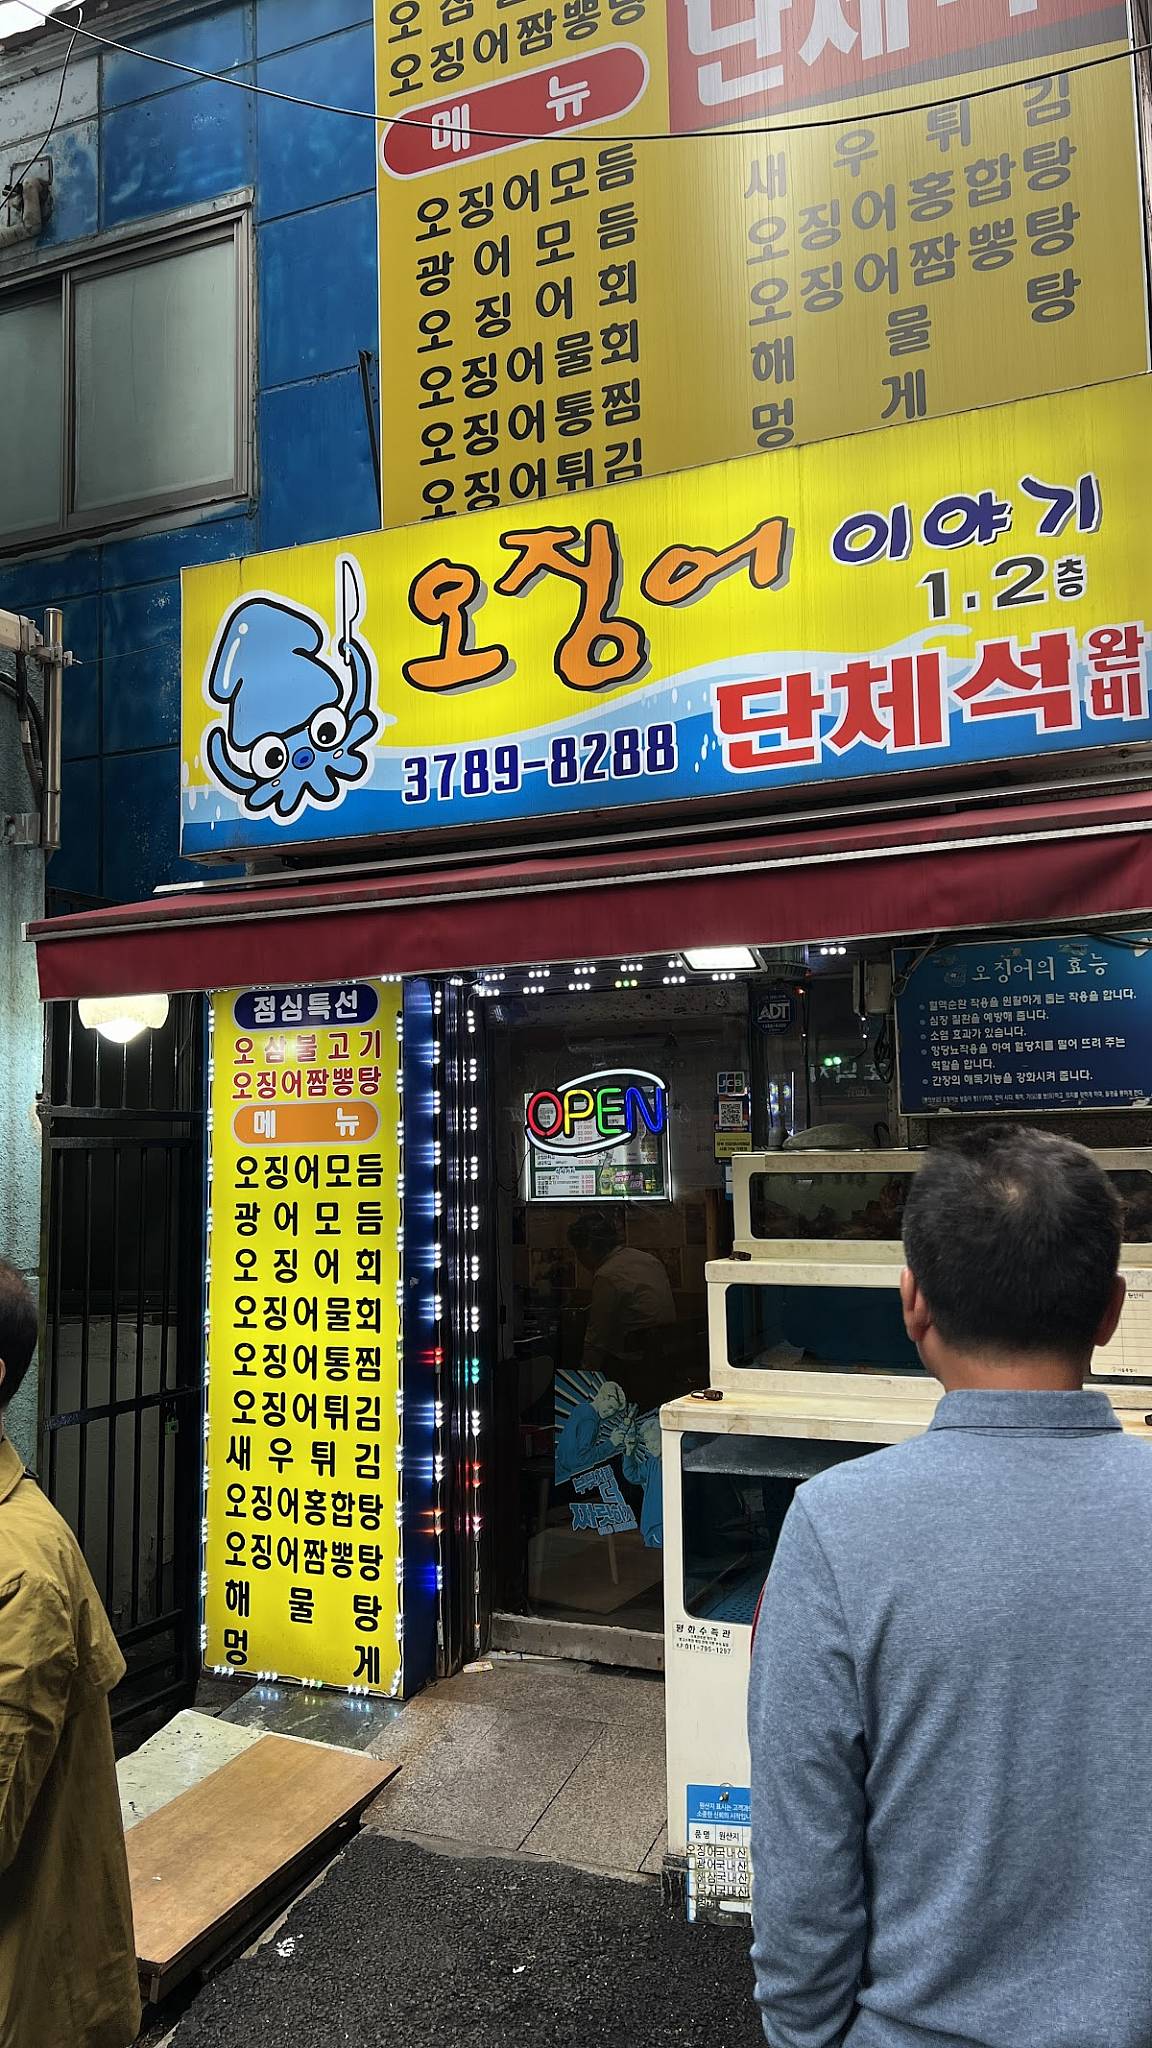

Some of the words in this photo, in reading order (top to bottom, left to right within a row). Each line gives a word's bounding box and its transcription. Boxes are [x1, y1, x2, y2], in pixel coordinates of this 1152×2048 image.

[415, 143, 638, 242] 오징어모듬
[746, 136, 1078, 265] 오징어홍합탕
[416, 201, 639, 297] 광어모듬
[748, 201, 1081, 327] 오징어짬뽕탕
[417, 260, 638, 353] 오징어회
[418, 319, 639, 410] 오징어물회
[419, 378, 641, 466] 오징어통찜
[420, 438, 643, 521] 오징어튀김
[402, 518, 793, 692] 오징어
[831, 473, 1100, 565] 이야기
[716, 632, 1074, 770] 단체석
[404, 723, 676, 803] 3789-8288
[972, 956, 1055, 983] 오징어의
[1067, 953, 1109, 976] 효능
[253, 990, 358, 1024] 점심특선
[757, 1002, 790, 1020] ADT
[929, 1015, 948, 1026] 심장
[951, 1013, 981, 1026] 질환을
[984, 1011, 1013, 1023] 예방해
[1016, 1009, 1049, 1021] 줍니다.
[970, 996, 999, 1009] 작용을
[1069, 991, 1099, 1003] 작용을
[1103, 988, 1137, 1000] 합니다.
[930, 1030, 949, 1041] 소염
[952, 1028, 981, 1040] 효과가
[984, 1026, 1027, 1039] 있습니다.
[1105, 1036, 1126, 1048] 주는
[232, 1066, 382, 1100] 오징어짬뽕탕
[718, 1079, 743, 1088] JCB
[932, 1074, 961, 1087] 간장의
[1016, 1071, 1056, 1083] 강화시켜
[1059, 1069, 1093, 1081] 줍니다.
[964, 1057, 996, 1070] 합니다.
[527, 1086, 663, 1136] OPEN
[234, 1153, 384, 1189] 오징어모듬
[234, 1201, 384, 1237] 광어모듬
[233, 1248, 381, 1285] 오징어회
[233, 1295, 381, 1333] 오징어물회
[232, 1342, 381, 1382] 오징어통찜
[231, 1389, 381, 1432] 오징어튀김
[226, 1435, 381, 1480] 새우튀김
[225, 1483, 384, 1531] 오징어홍합탕
[225, 1531, 384, 1582] 오징어짬뽕탕
